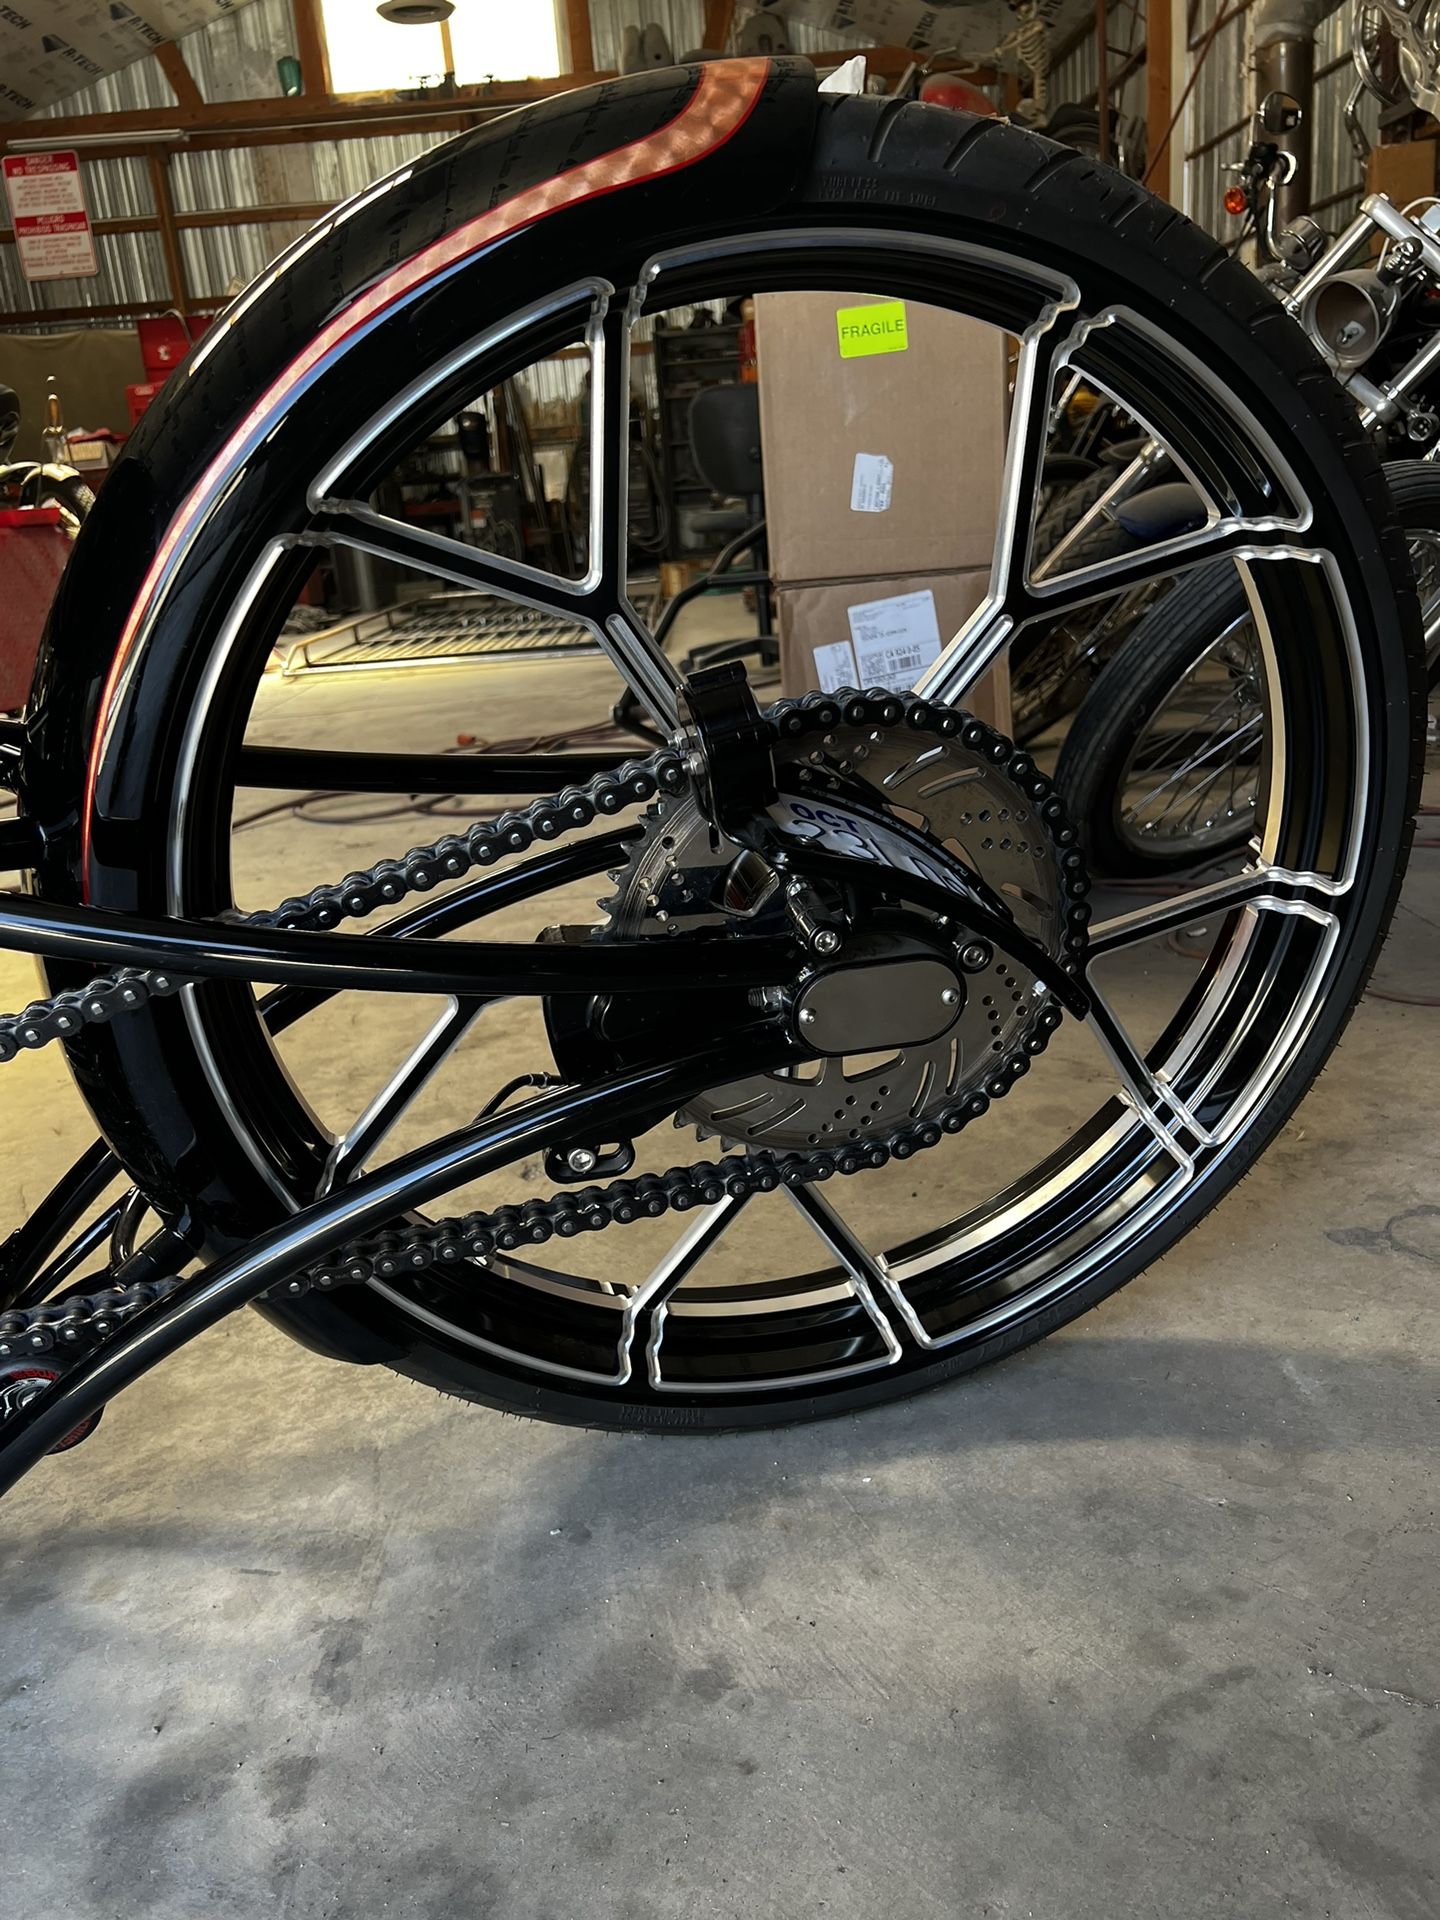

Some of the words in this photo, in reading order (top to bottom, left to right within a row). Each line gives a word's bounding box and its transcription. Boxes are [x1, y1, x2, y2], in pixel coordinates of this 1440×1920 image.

[12, 166, 24, 175] NO
[841, 319, 904, 340] FRAGILE
[789, 803, 859, 834] OCT
